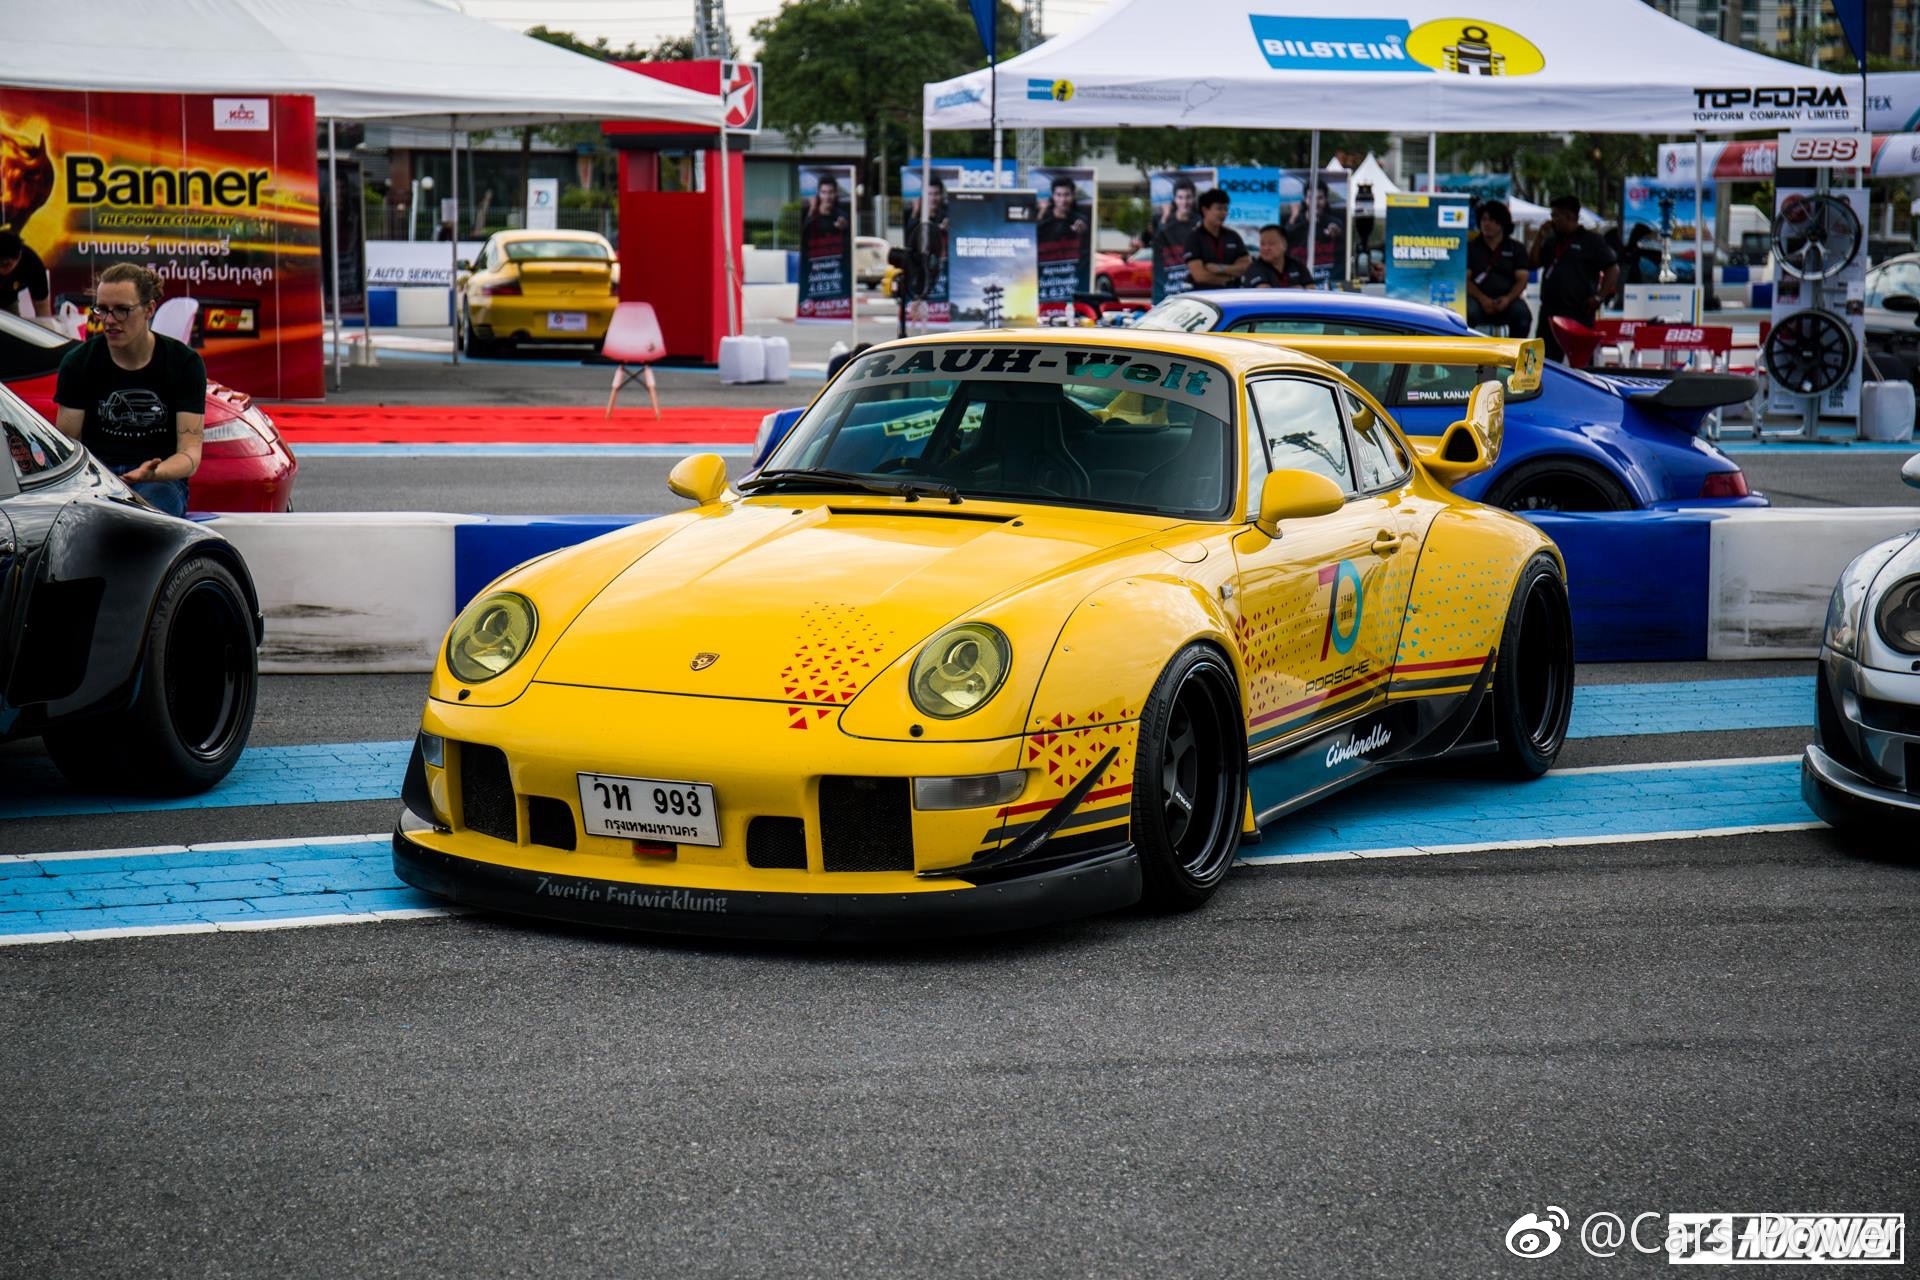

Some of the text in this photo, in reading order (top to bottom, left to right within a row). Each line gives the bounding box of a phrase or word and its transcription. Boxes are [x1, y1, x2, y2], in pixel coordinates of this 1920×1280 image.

[1262, 38, 1405, 60] BILSTEIN
[1693, 110, 1849, 121] TOPFORM COMPANY LIMITED
[1791, 138, 1858, 161] BBS
[66, 156, 269, 207] Banner
[100, 214, 234, 226] THE POWER COMPANY
[78, 235, 150, 255] บานเนอร์
[374, 267, 404, 279] AUTO
[1665, 329, 1704, 342] BBS
[849, 348, 1213, 396] RAUH-Welt
[1420, 391, 1473, 400] PAUL KANJA
[165, 559, 202, 599] MICHELIN
[1305, 659, 1369, 696] PORSCHE
[1325, 723, 1391, 768] Cinderella
[594, 781, 701, 817] วห 993
[604, 818, 698, 837] กรุงเทพมหานคร
